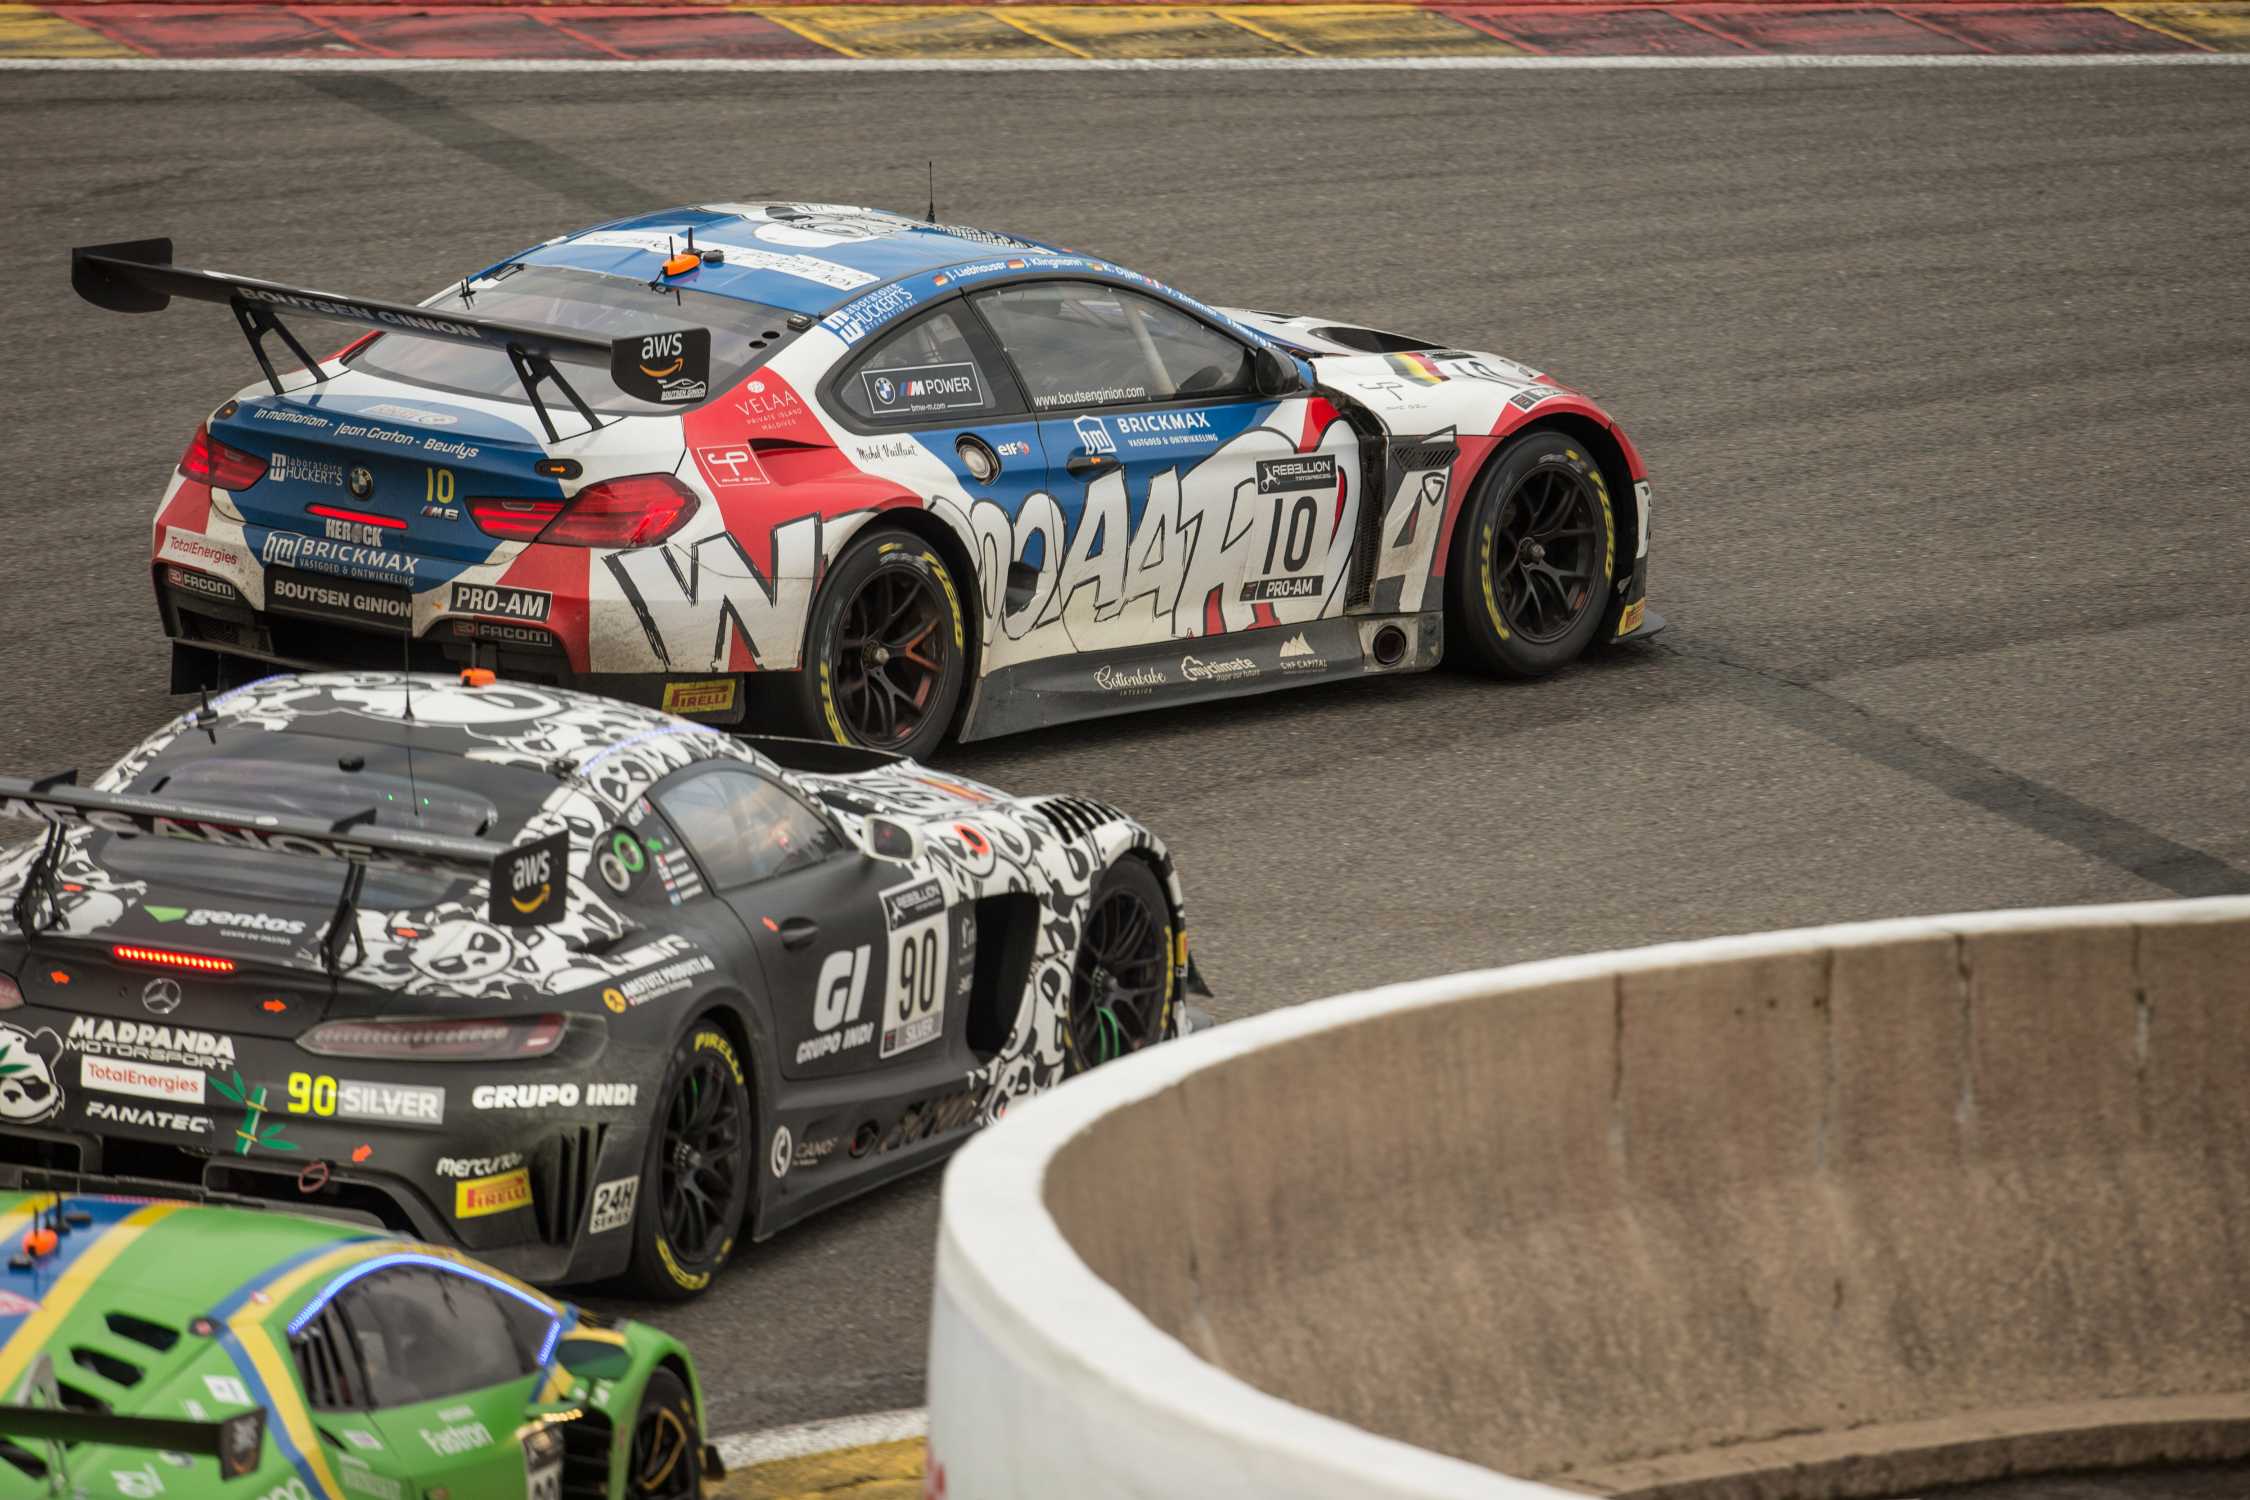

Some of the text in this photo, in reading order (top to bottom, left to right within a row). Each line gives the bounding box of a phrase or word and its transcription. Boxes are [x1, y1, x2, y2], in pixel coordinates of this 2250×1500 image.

[376, 310, 481, 339] GINION
[641, 332, 683, 360] aws
[926, 376, 972, 395] POWER
[1033, 386, 1145, 408] www.boutsenginion.com
[735, 390, 798, 416] VELAA
[255, 408, 268, 420] In
[424, 438, 480, 460] Beurlys
[1117, 411, 1211, 434] BRICKMAX
[997, 442, 1019, 456] elf
[286, 465, 344, 488] HUCKERT'S
[1272, 460, 1331, 477] REBELLION
[426, 466, 456, 504] 10
[1261, 495, 1318, 576] 10
[170, 536, 239, 567] TotalEnergies
[302, 539, 420, 575] BRICKMAX
[351, 567, 416, 587] ONTWIKKELING
[1265, 578, 1314, 598] PRO-AM
[274, 579, 413, 618] BOUTSEN GINION
[456, 586, 545, 618] PRO-AM
[671, 684, 730, 709] PIRELLI
[512, 849, 551, 892] aws
[898, 927, 937, 1022] 90
[68, 1015, 236, 1061] MADPANDA
[65, 1037, 234, 1072] MOTORSPORT
[87, 1061, 199, 1095] TotalEnergies
[286, 1071, 440, 1120] 90 SILVER
[471, 1083, 639, 1110] GRUPO INDI
[86, 1100, 210, 1134] FANATEC
[596, 1181, 637, 1216] 24H
